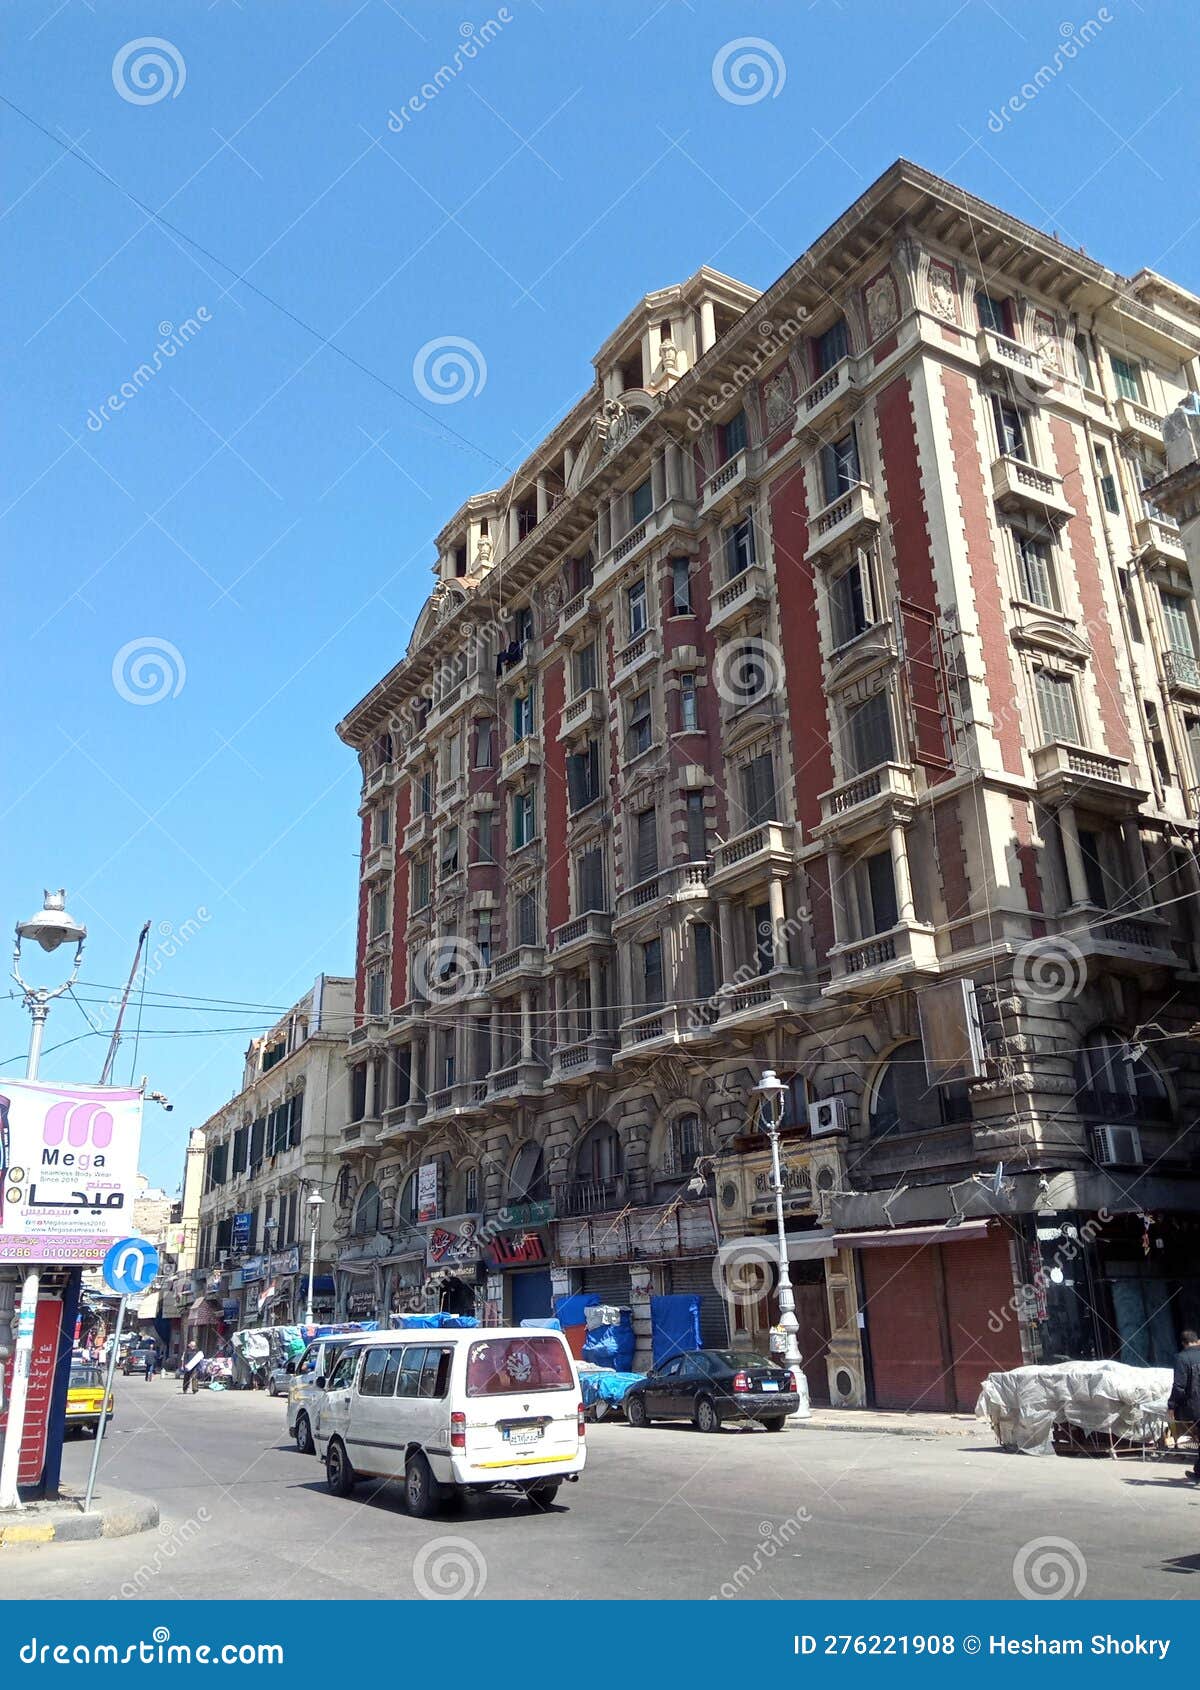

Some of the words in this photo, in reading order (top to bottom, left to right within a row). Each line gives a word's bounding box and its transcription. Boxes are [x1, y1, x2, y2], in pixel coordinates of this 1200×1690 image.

[41, 1148, 106, 1170] Mega
[86, 1180, 121, 1191] مصنع
[28, 1184, 124, 1215] ميجا
[1, 1247, 31, 1257] 4286
[43, 1248, 106, 1258] 010022696
